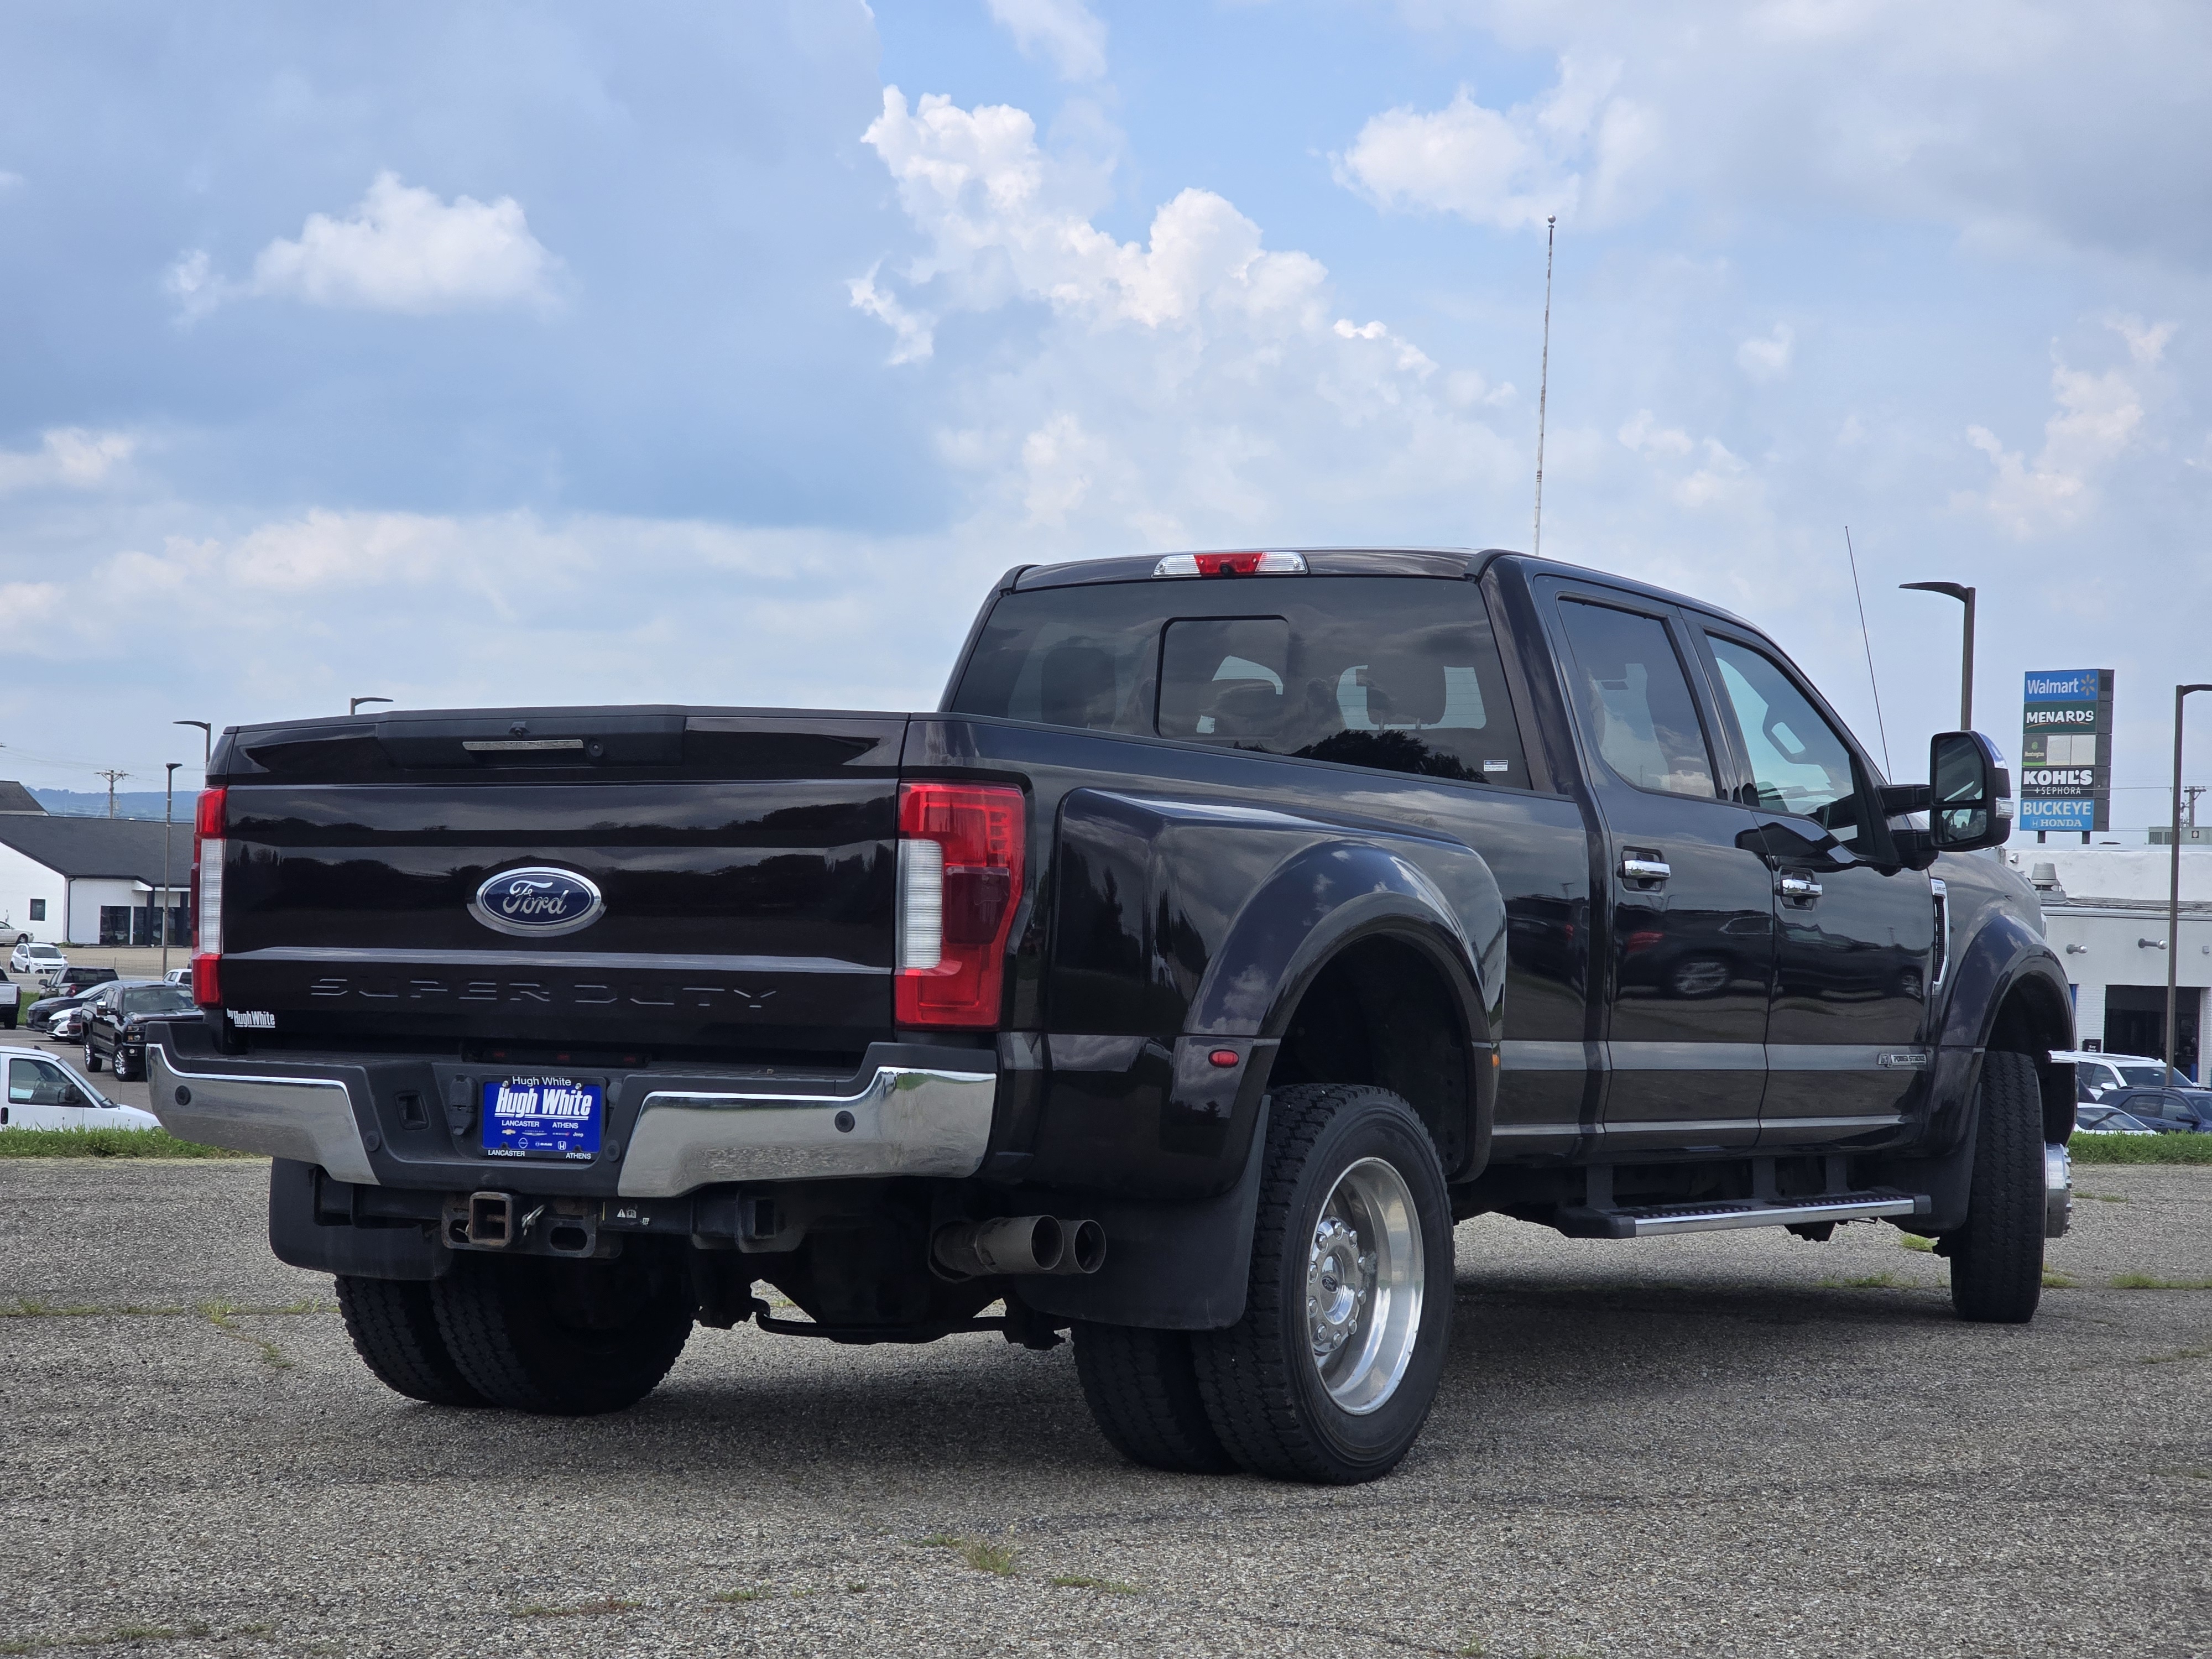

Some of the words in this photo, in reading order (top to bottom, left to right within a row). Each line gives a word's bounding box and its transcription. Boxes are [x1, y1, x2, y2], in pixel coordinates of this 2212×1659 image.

[2027, 677, 2079, 695] Walmart
[2026, 710, 2094, 723] MENARDS
[2023, 770, 2093, 785] KOHL'S
[2023, 801, 2091, 816] BUCKEYE
[2040, 819, 2083, 827] HONDA
[502, 880, 569, 915] Ford
[310, 977, 551, 1002] SUPER
[574, 982, 777, 1009] DUTY
[233, 1010, 252, 1027] Hugh
[251, 1011, 275, 1025] White
[512, 1076, 540, 1087] Hugh
[541, 1077, 572, 1086] White
[495, 1087, 538, 1118] Hugh
[542, 1088, 592, 1116] White
